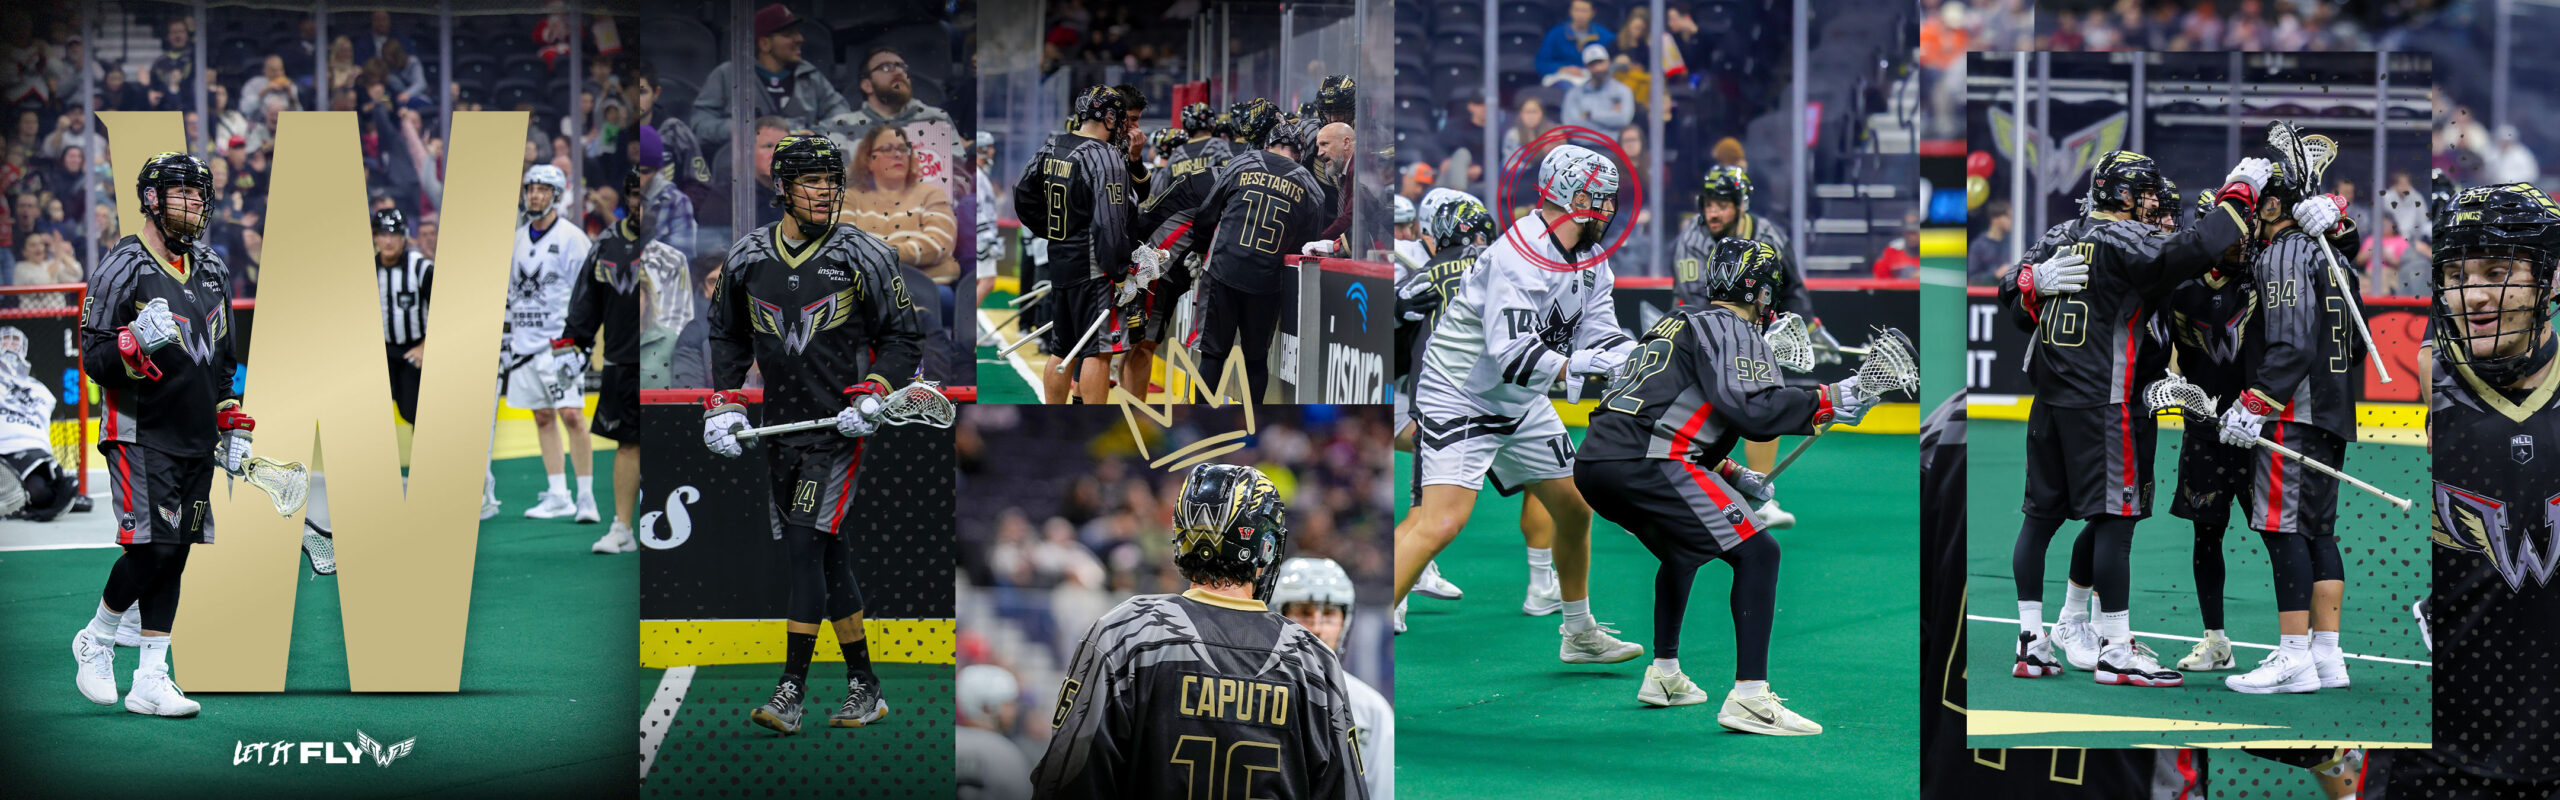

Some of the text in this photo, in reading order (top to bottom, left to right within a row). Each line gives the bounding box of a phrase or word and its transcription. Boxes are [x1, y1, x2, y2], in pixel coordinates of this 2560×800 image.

[1105, 182, 1124, 205] 19
[1239, 171, 1304, 203] RESETARITS
[1043, 180, 1067, 241] 19
[1239, 189, 1291, 254] 15
[2456, 211, 2481, 222] WINGS
[817, 266, 845, 278] inspira
[2267, 280, 2297, 309] 34
[1503, 308, 1533, 340] 14
[1651, 317, 1685, 340] AIR
[1969, 304, 1998, 342] IT
[1326, 315, 1383, 404] inspira
[1736, 357, 1773, 382] 92
[1547, 432, 1576, 468] 14
[2512, 437, 2531, 445] NLL
[1722, 502, 1737, 515] NLL
[1180, 675, 1289, 726] CAPUTO
